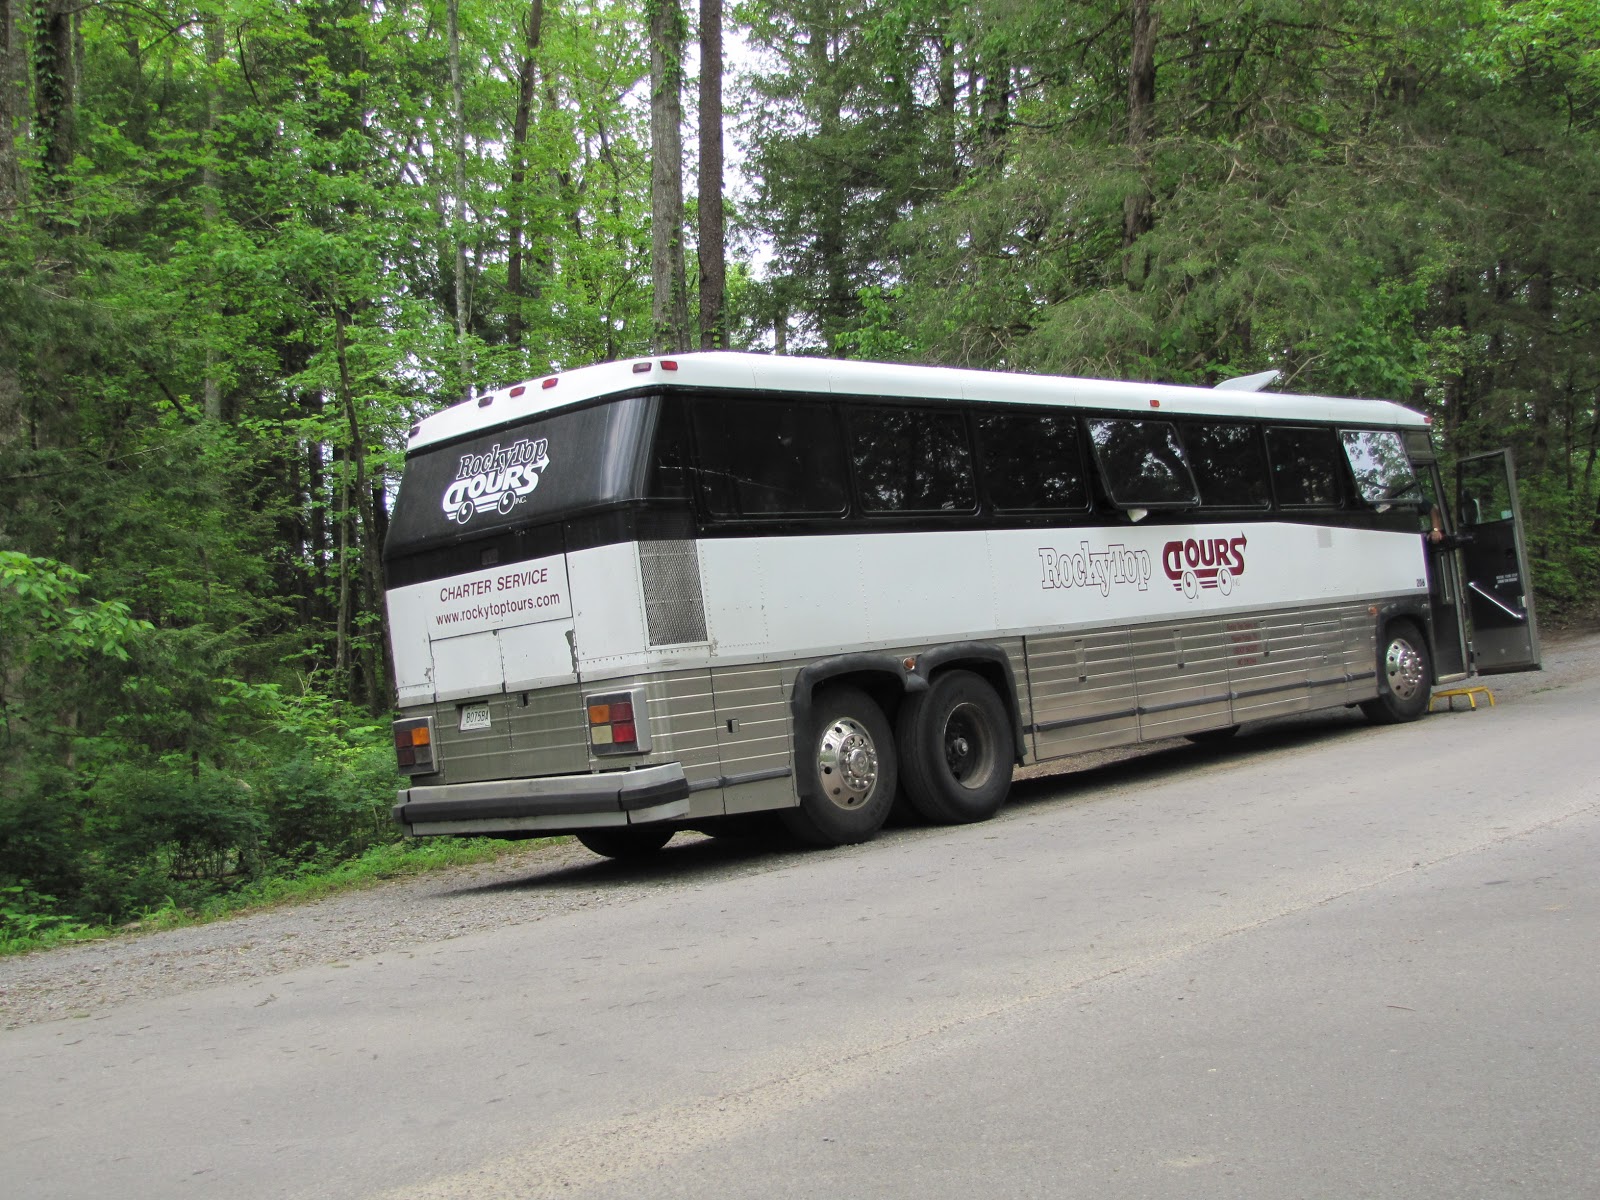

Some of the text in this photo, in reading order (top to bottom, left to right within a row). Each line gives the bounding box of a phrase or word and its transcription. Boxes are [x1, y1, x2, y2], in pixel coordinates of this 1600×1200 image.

[443, 460, 549, 513] TOURS
[1162, 532, 1247, 581] TOURS
[440, 568, 548, 603] CHARTER SERVICE
[436, 592, 561, 626] www.rockytoptours.com
